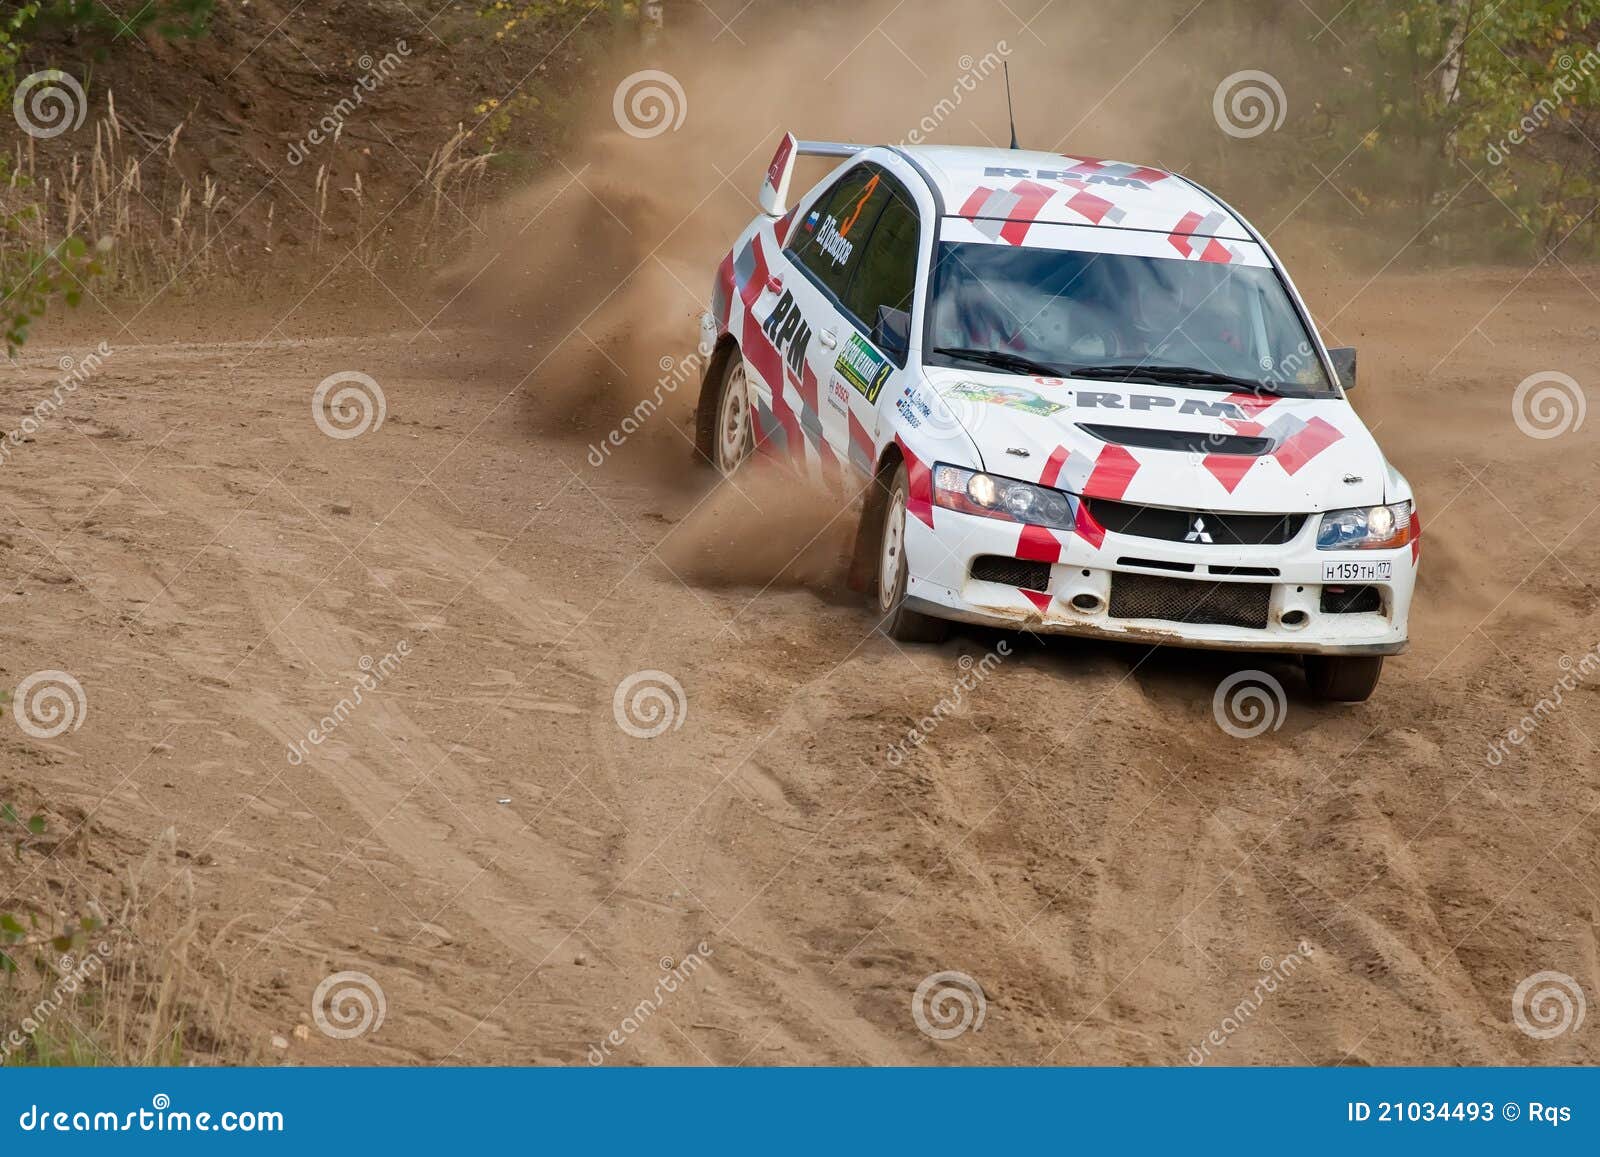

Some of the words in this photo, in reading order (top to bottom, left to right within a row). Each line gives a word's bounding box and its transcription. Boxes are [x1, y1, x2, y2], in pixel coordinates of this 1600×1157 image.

[983, 167, 1152, 190] RPM
[840, 174, 879, 238] 3
[762, 288, 812, 381] RPM
[1076, 391, 1247, 420] RPM
[1378, 562, 1391, 574] 177
